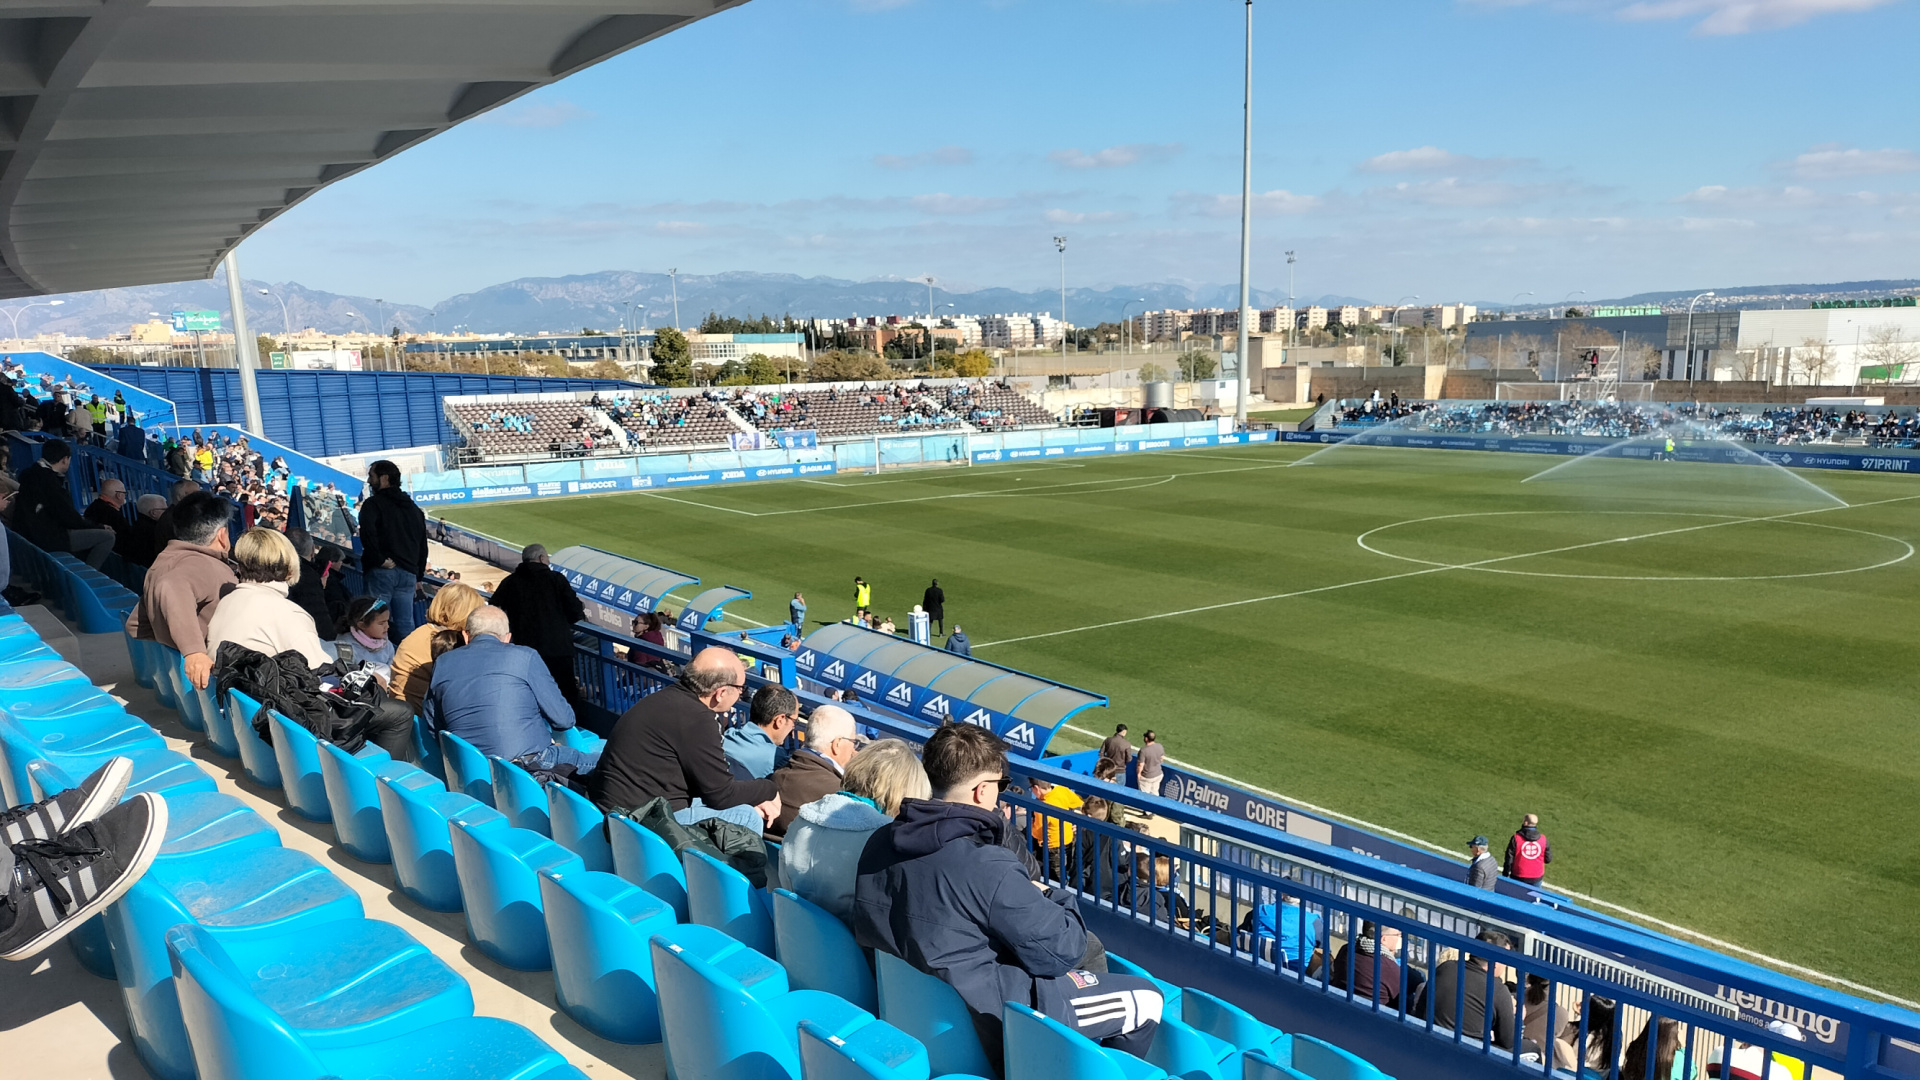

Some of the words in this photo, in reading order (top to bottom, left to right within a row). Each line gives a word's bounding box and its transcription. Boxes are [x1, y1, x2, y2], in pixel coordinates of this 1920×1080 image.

[1816, 458, 1850, 466] HYUNDAI
[1861, 457, 1910, 471] 971PRINT
[767, 467, 793, 475] HYUNDAI
[807, 464, 832, 472] AGUILAR
[579, 480, 617, 491] BESOCCER
[415, 492, 440, 502] CAFÉ
[442, 491, 466, 500] RICO
[1002, 736, 1034, 752] conectabalear
[1185, 779, 1230, 811] Palma
[1246, 800, 1286, 831] CORE
